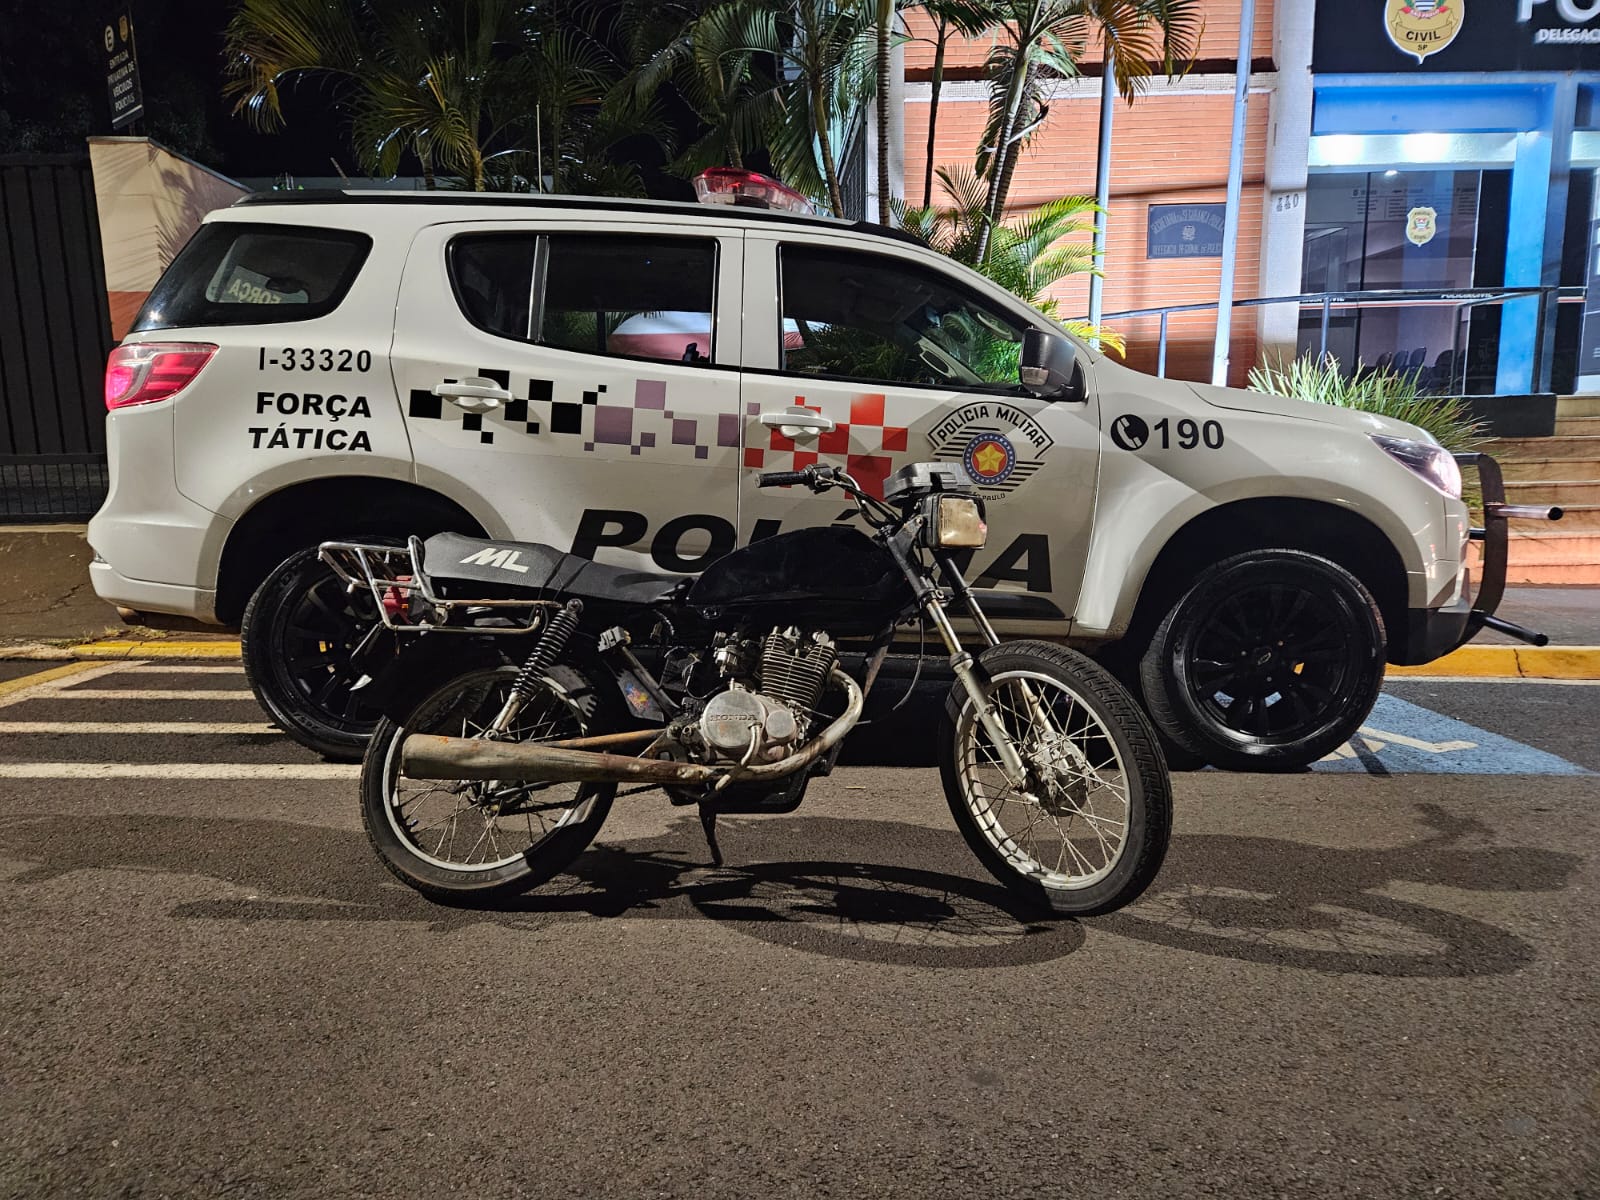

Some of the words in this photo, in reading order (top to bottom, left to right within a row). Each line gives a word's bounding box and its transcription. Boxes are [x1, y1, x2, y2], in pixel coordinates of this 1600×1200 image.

[1406, 31, 1441, 41] CIVIL
[259, 347, 371, 372] I-33320
[256, 391, 371, 422] FORÇA
[248, 422, 372, 452] TÁTICA
[936, 405, 989, 442] POLÍCIA
[995, 406, 1046, 449] MILITAR
[1154, 417, 1224, 450] 190
[459, 547, 529, 573] ML
[709, 713, 758, 721] HONDA
